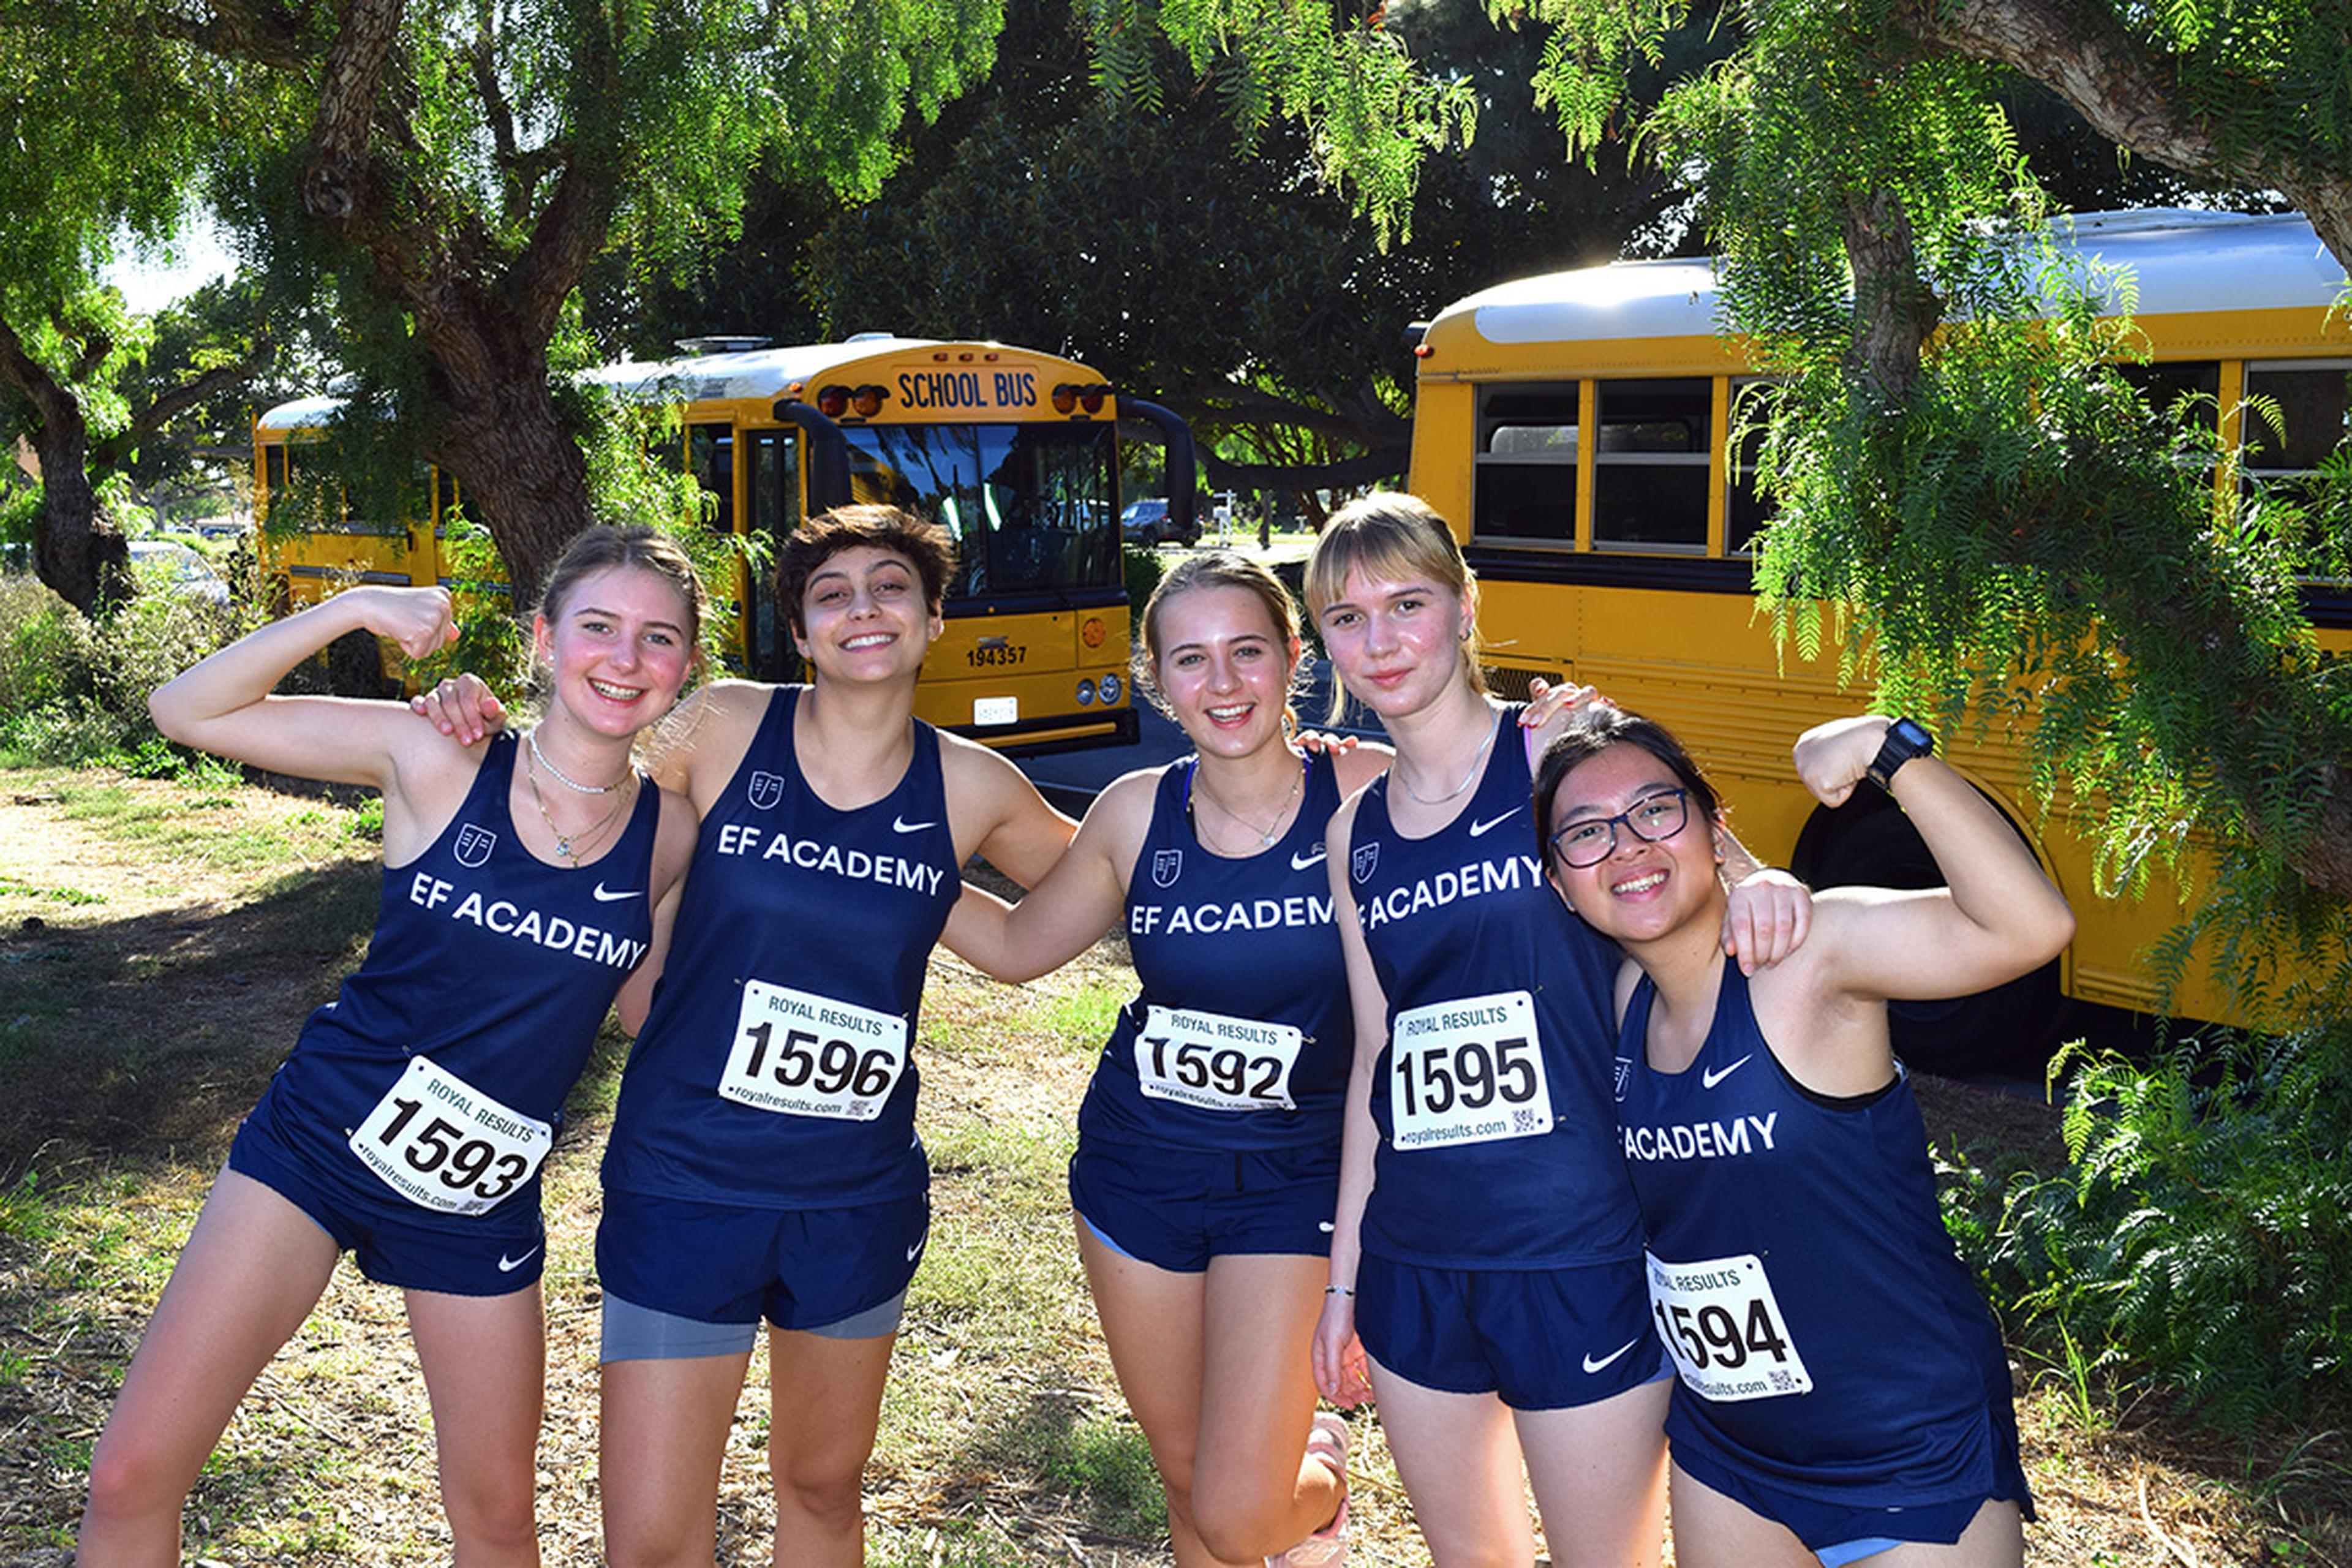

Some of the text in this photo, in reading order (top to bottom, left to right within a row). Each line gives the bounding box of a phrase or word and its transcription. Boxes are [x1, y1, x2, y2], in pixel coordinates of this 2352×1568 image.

[898, 372, 1037, 408] SCHOOL BUS
[967, 646, 1027, 666] 194357
[717, 824, 944, 896] EF ACADEMY
[410, 872, 647, 970] EF ACADEMY
[1131, 905, 1162, 934] EF
[1166, 895, 1339, 934] ACADEM
[1370, 855, 1542, 930] ACADEMY
[769, 995, 883, 1036] ROYAL RESULTS
[1171, 1014, 1278, 1046] ROYAL RESULTS
[1442, 1006, 1508, 1030] RESULTS
[745, 1021, 896, 1097] 1596
[1144, 1037, 1284, 1100] 1592
[1396, 1037, 1537, 1116] 1595
[427, 1078, 535, 1143] ROYAL RESULTS
[735, 1087, 842, 1114] royalresults.com
[378, 1097, 528, 1199] 1593
[1625, 1112, 1777, 1160] ACADEMY
[362, 1146, 458, 1209] royalresults.com
[1675, 1269, 1741, 1292] RESULTS
[1655, 1298, 1787, 1369] 1594
